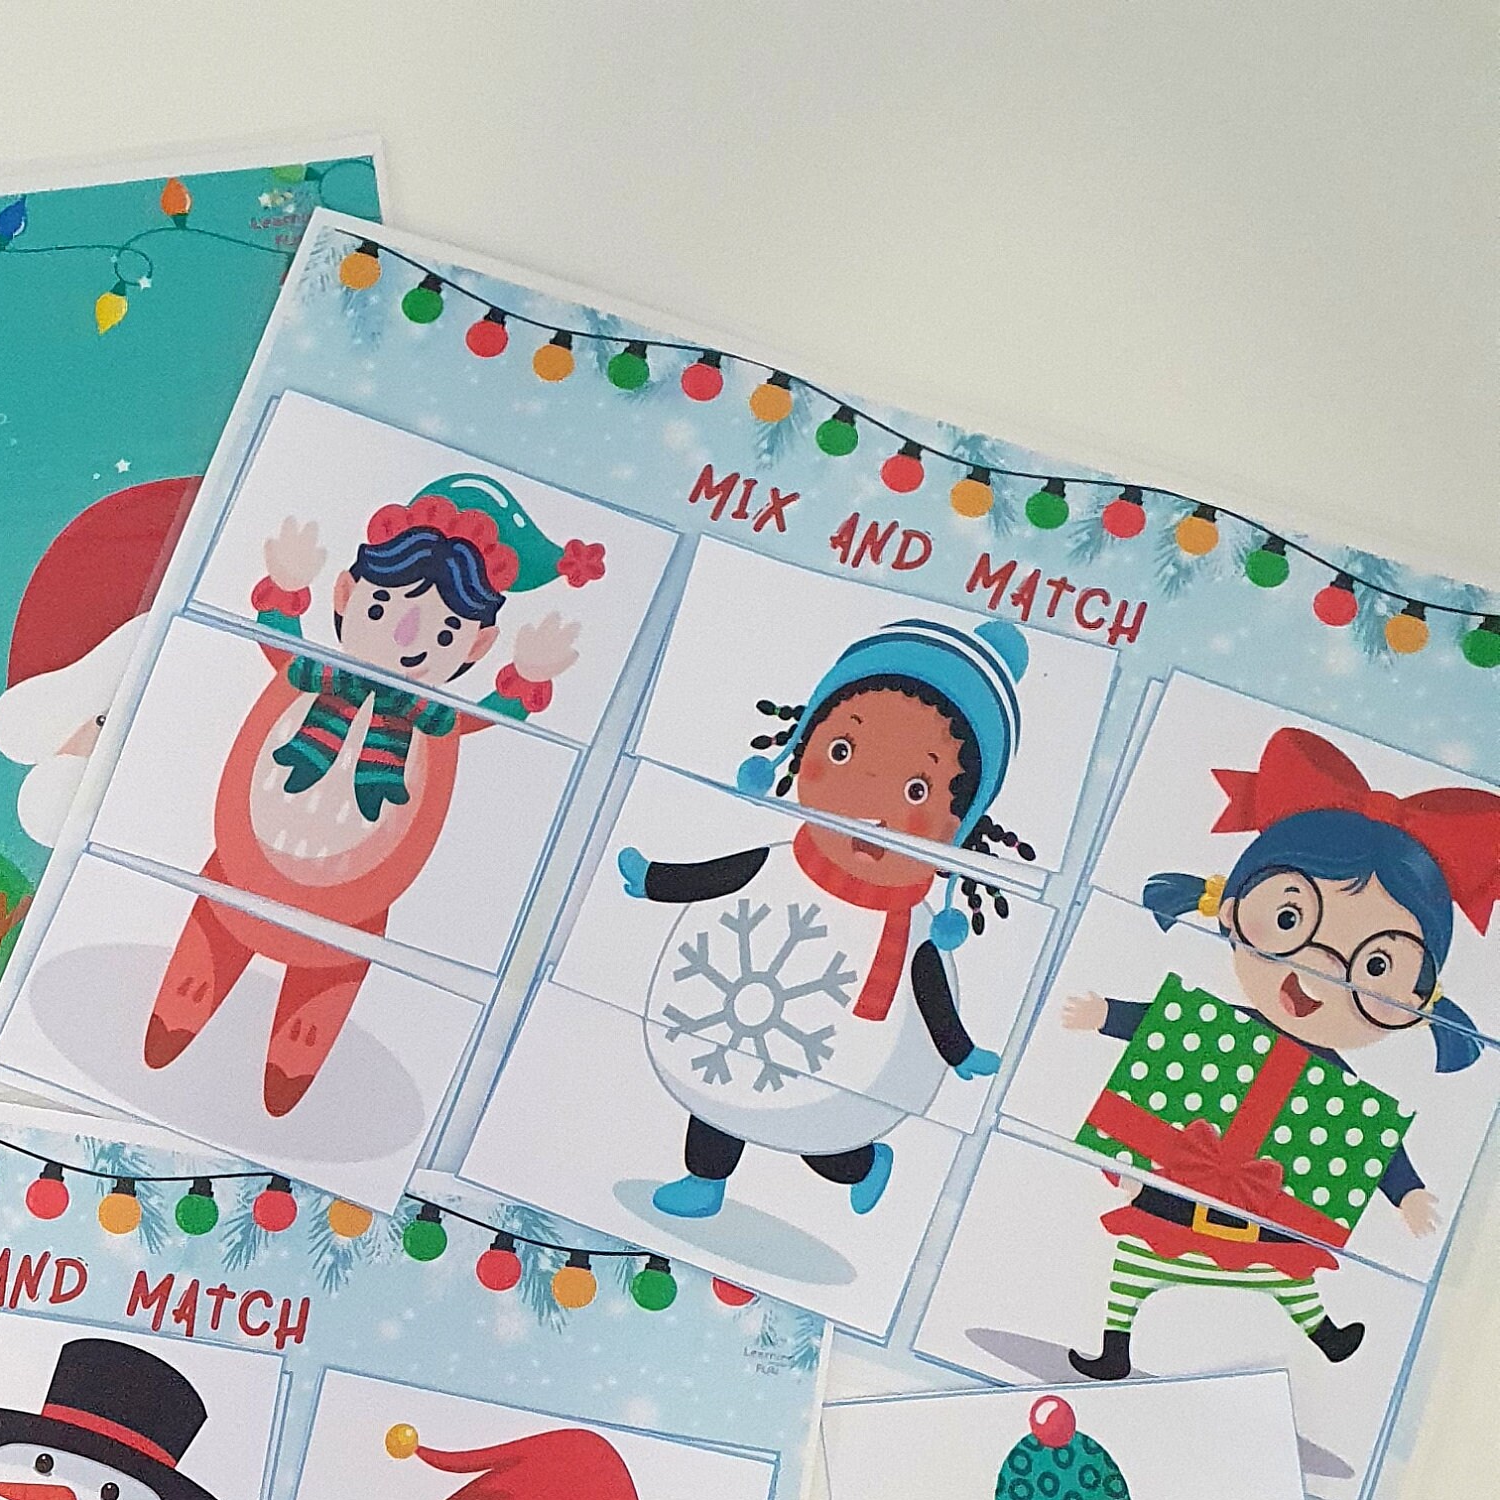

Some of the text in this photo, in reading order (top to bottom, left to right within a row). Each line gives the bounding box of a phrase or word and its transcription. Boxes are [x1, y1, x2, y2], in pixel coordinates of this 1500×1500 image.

[688, 465, 1147, 645] MIX AND MATCH
[126, 1271, 310, 1349] MATCH
